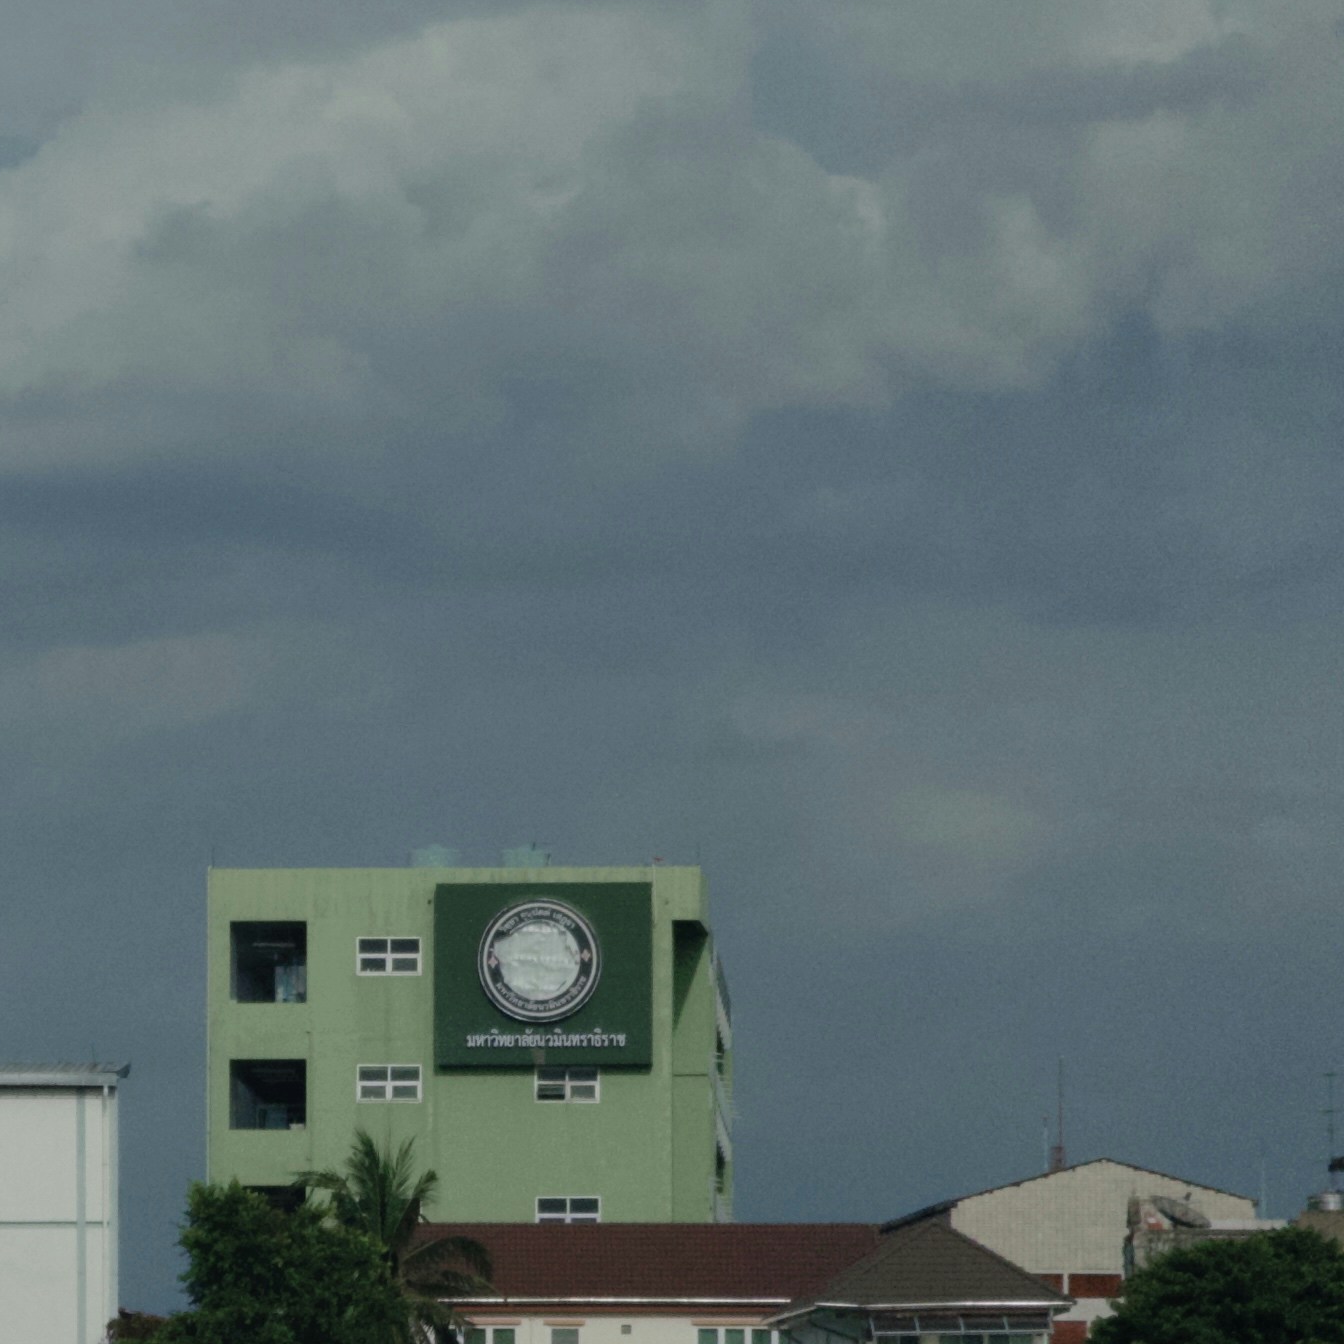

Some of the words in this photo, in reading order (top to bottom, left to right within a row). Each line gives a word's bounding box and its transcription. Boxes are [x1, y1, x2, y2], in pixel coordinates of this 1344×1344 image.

[466, 1028, 626, 1047] มหาวิทยาลัยนวมินทราธิราช
